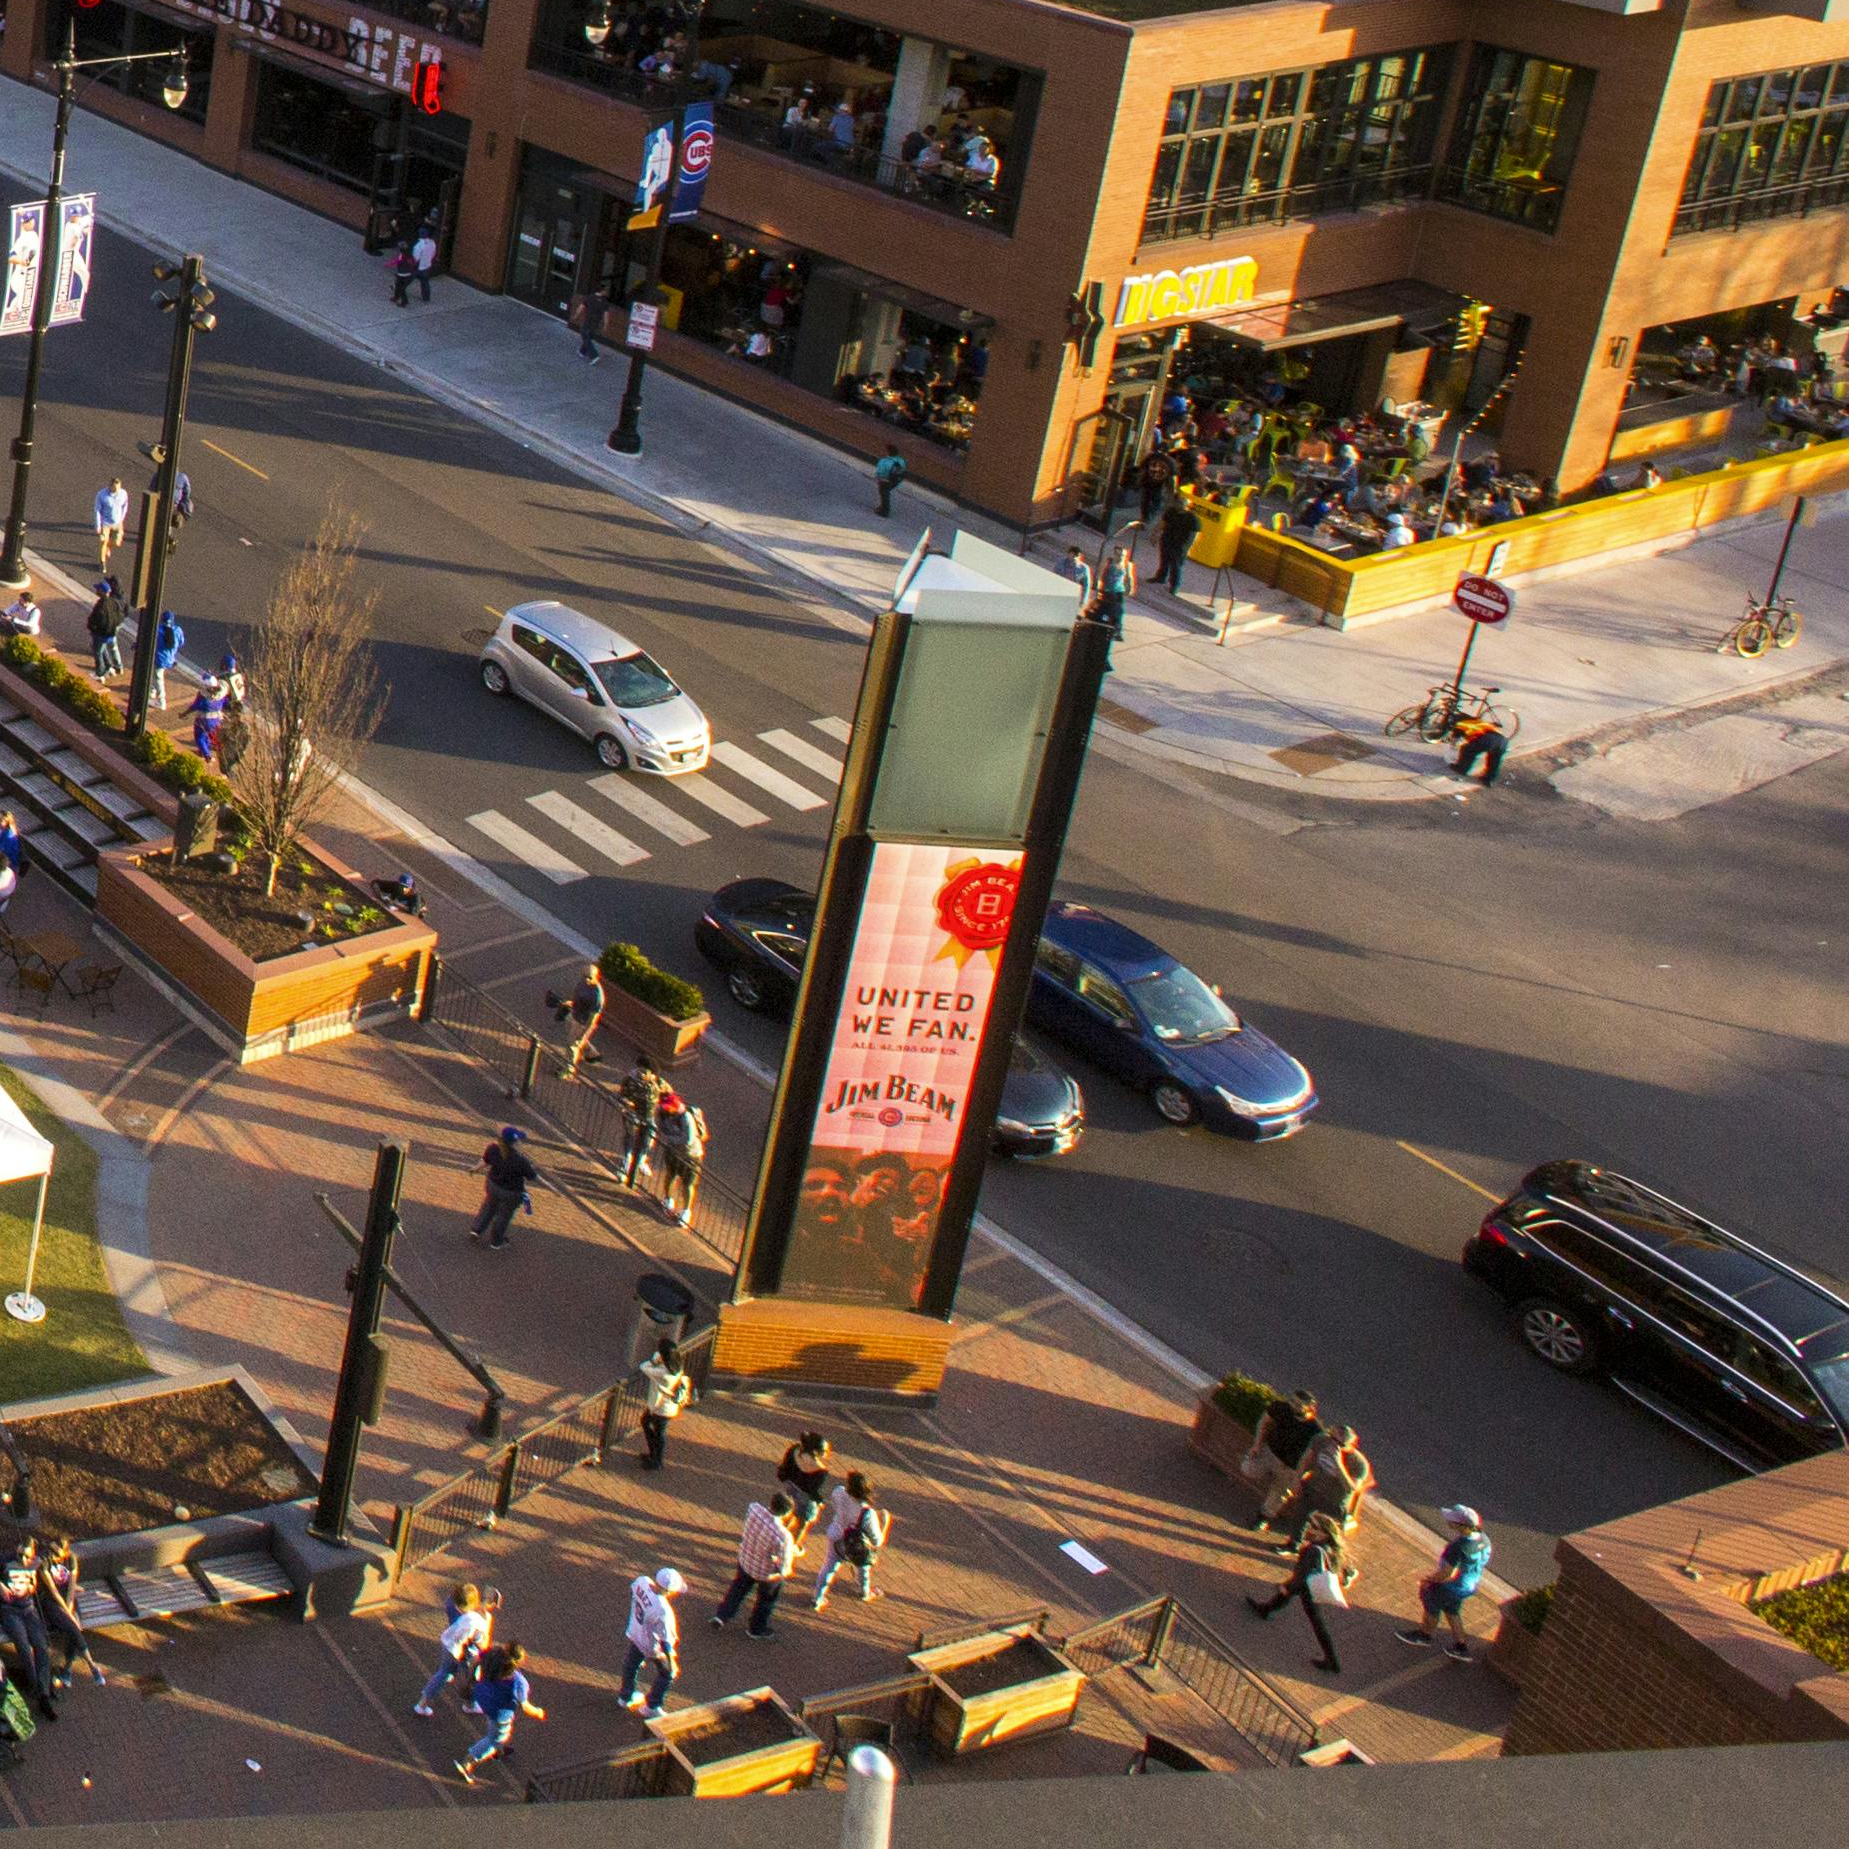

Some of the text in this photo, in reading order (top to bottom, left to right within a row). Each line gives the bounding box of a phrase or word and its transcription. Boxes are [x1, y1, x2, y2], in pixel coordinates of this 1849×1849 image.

[57, 251, 73, 303] SCHWARBER
[1464, 581, 1505, 601] DO NOT
[1463, 601, 1495, 619] ENTER
[961, 876, 1015, 896] JIM BEA
[954, 905, 986, 931] SINCE
[857, 986, 976, 1012] UNITED
[853, 1014, 976, 1041] WE FAN.
